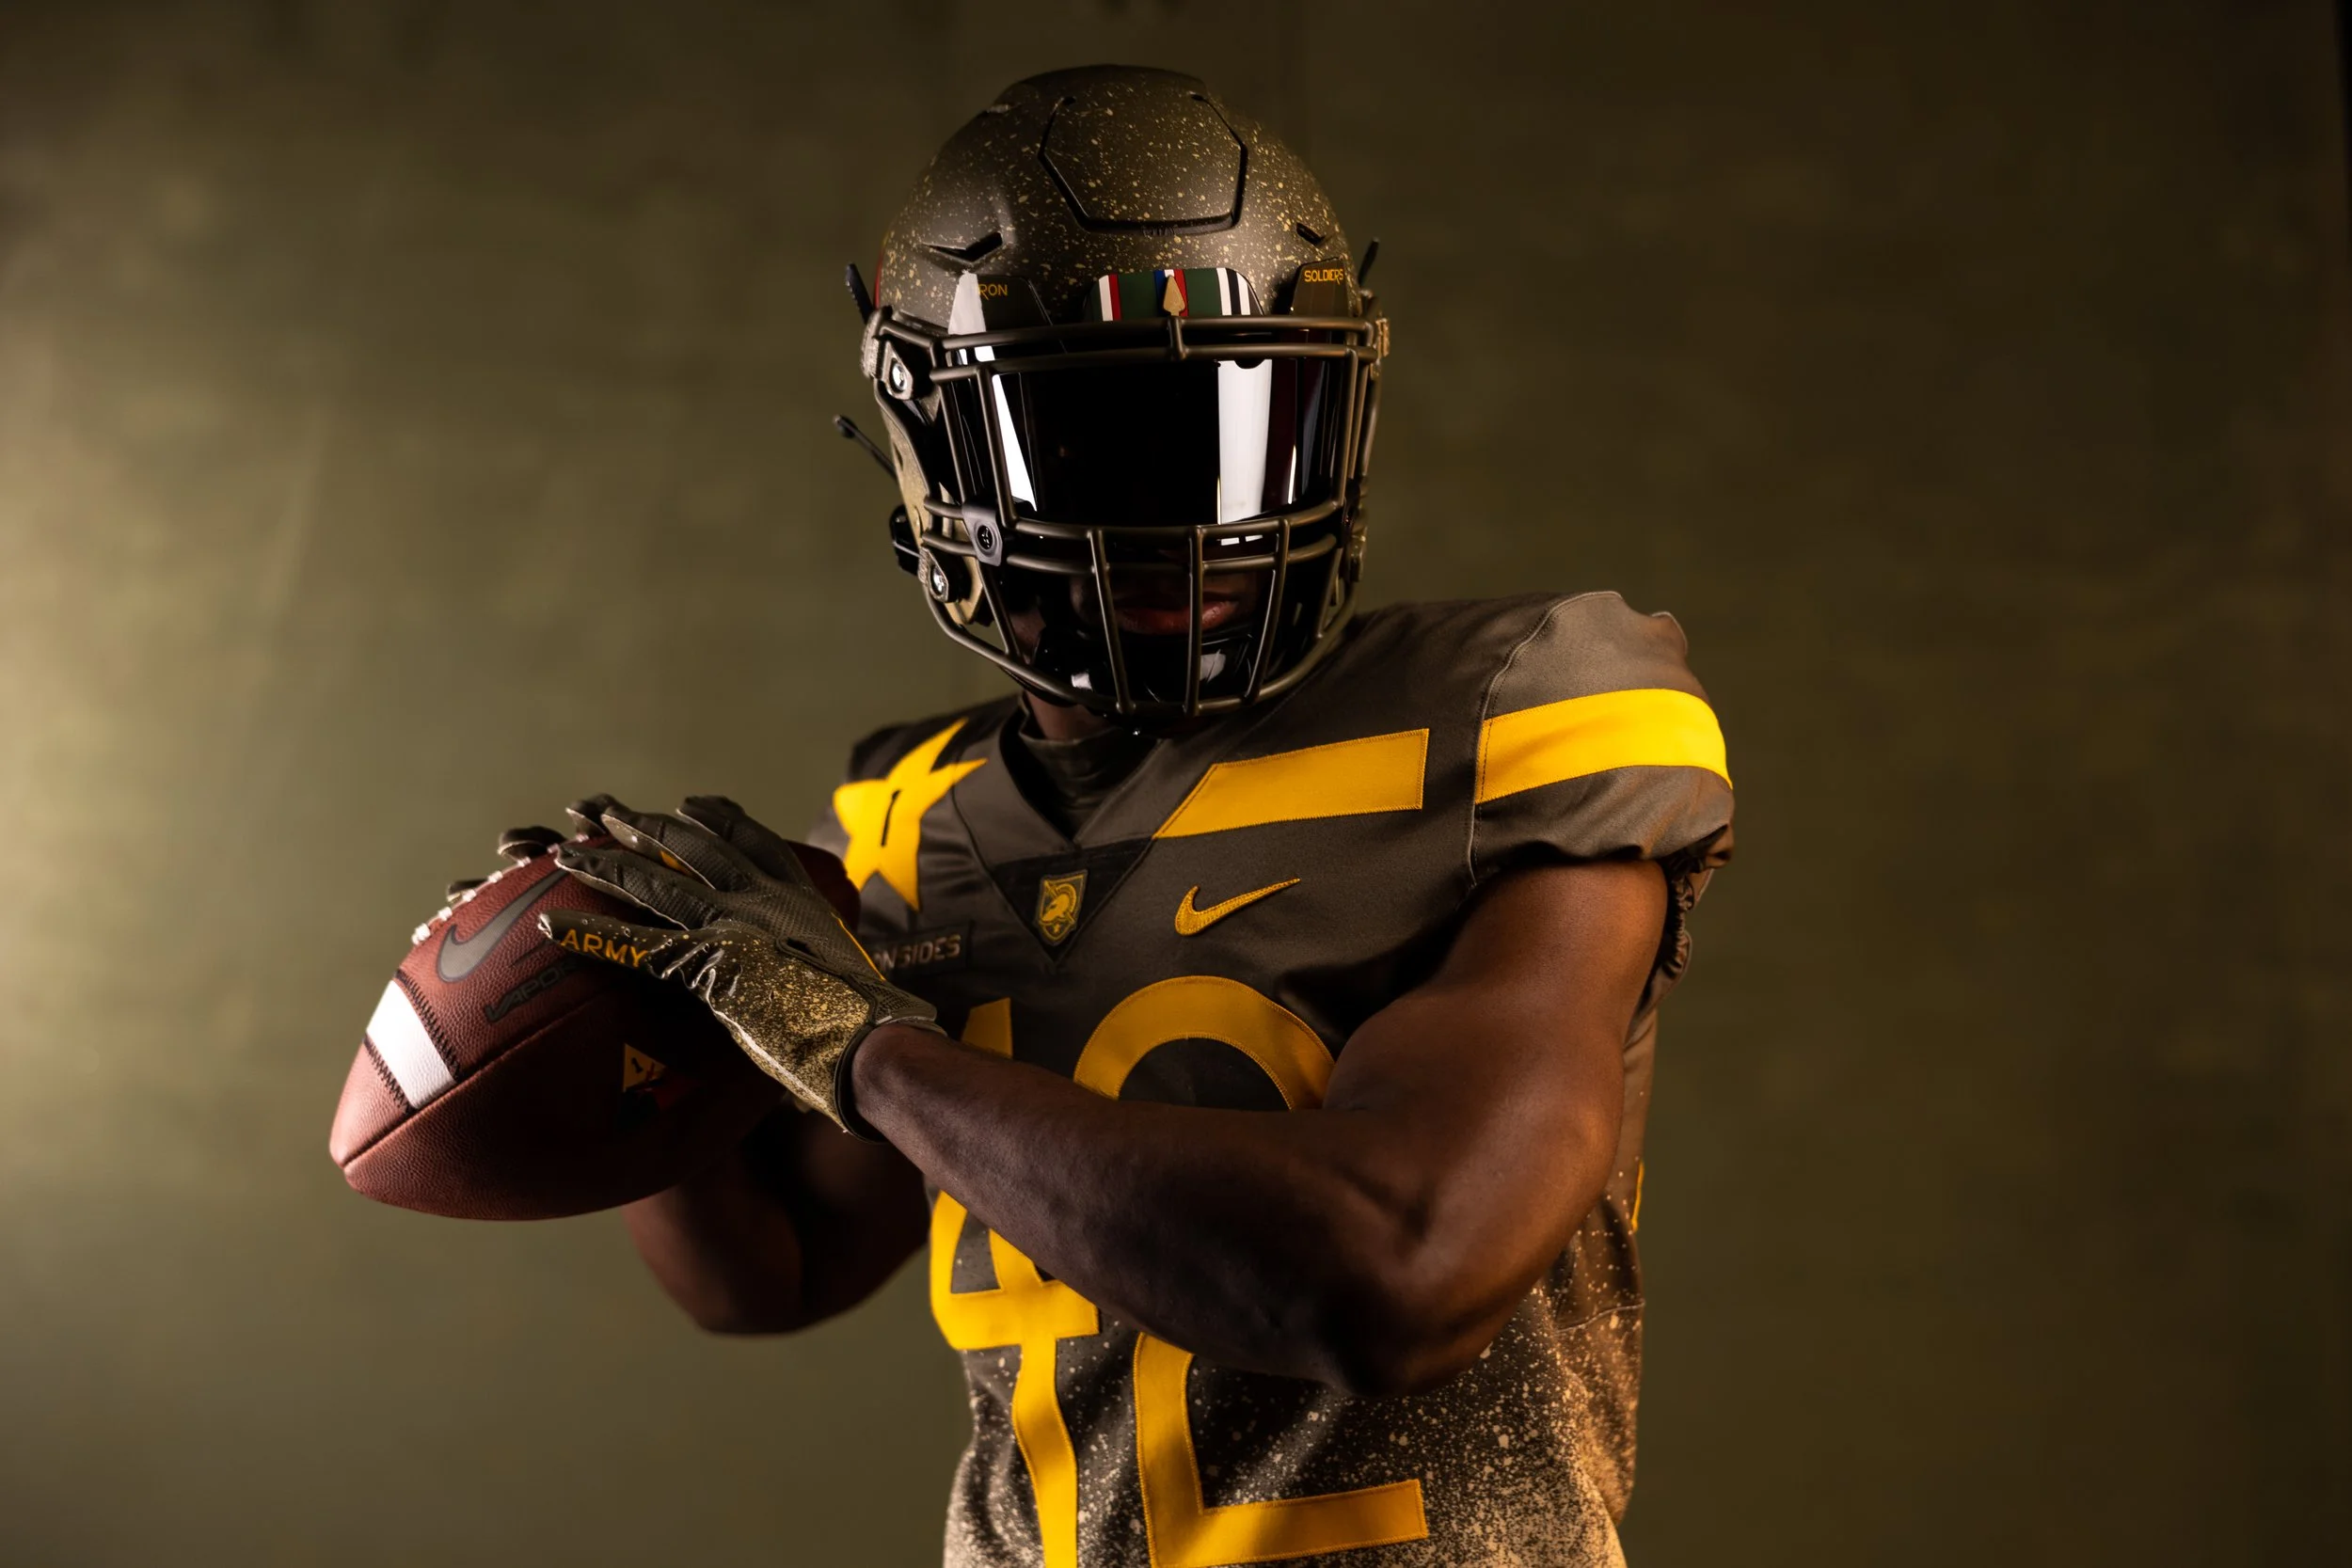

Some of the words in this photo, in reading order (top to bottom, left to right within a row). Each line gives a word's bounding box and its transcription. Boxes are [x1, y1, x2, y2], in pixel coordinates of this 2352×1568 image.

[1304, 268, 1344, 285] SOLDIERS
[977, 283, 1009, 300] RON
[560, 927, 648, 969] ARMY
